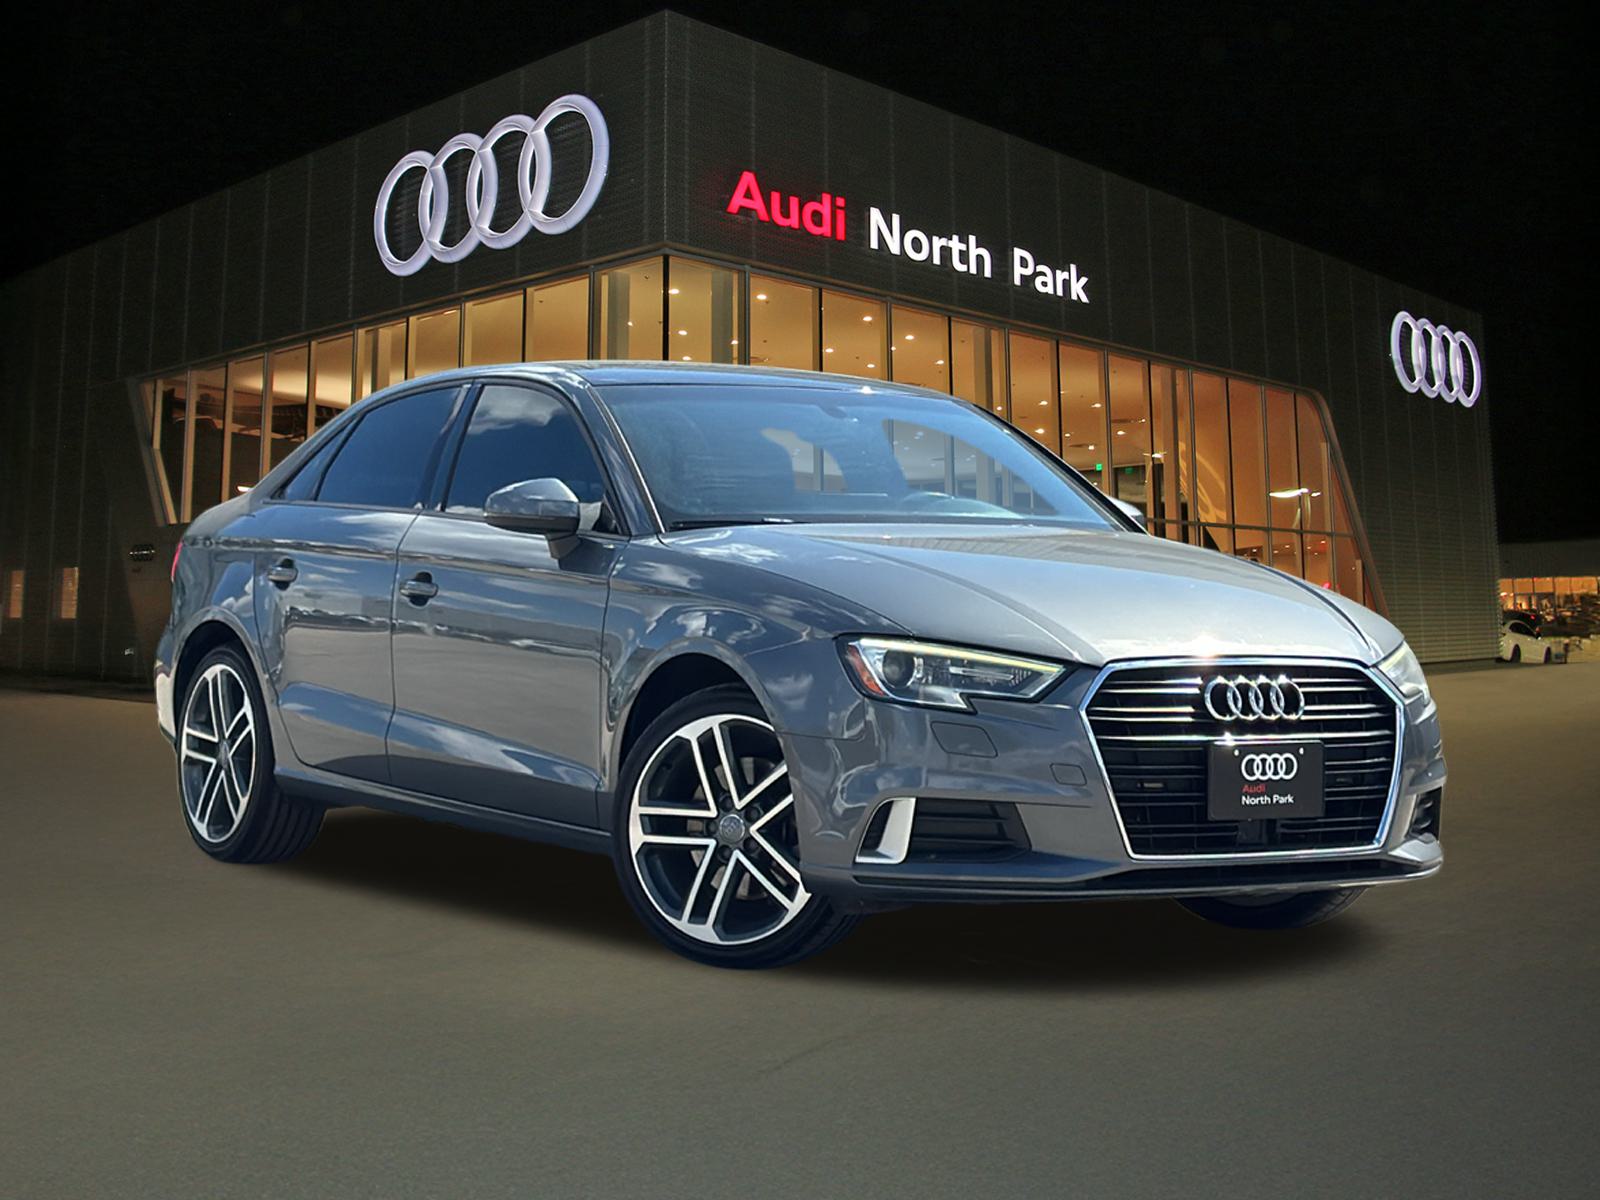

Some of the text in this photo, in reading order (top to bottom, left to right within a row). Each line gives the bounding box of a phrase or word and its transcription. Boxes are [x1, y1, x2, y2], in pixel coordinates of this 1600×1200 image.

[726, 170, 1090, 304] Audi North Park
[1242, 784, 1266, 793] Audi
[1241, 794, 1295, 805] North Park
